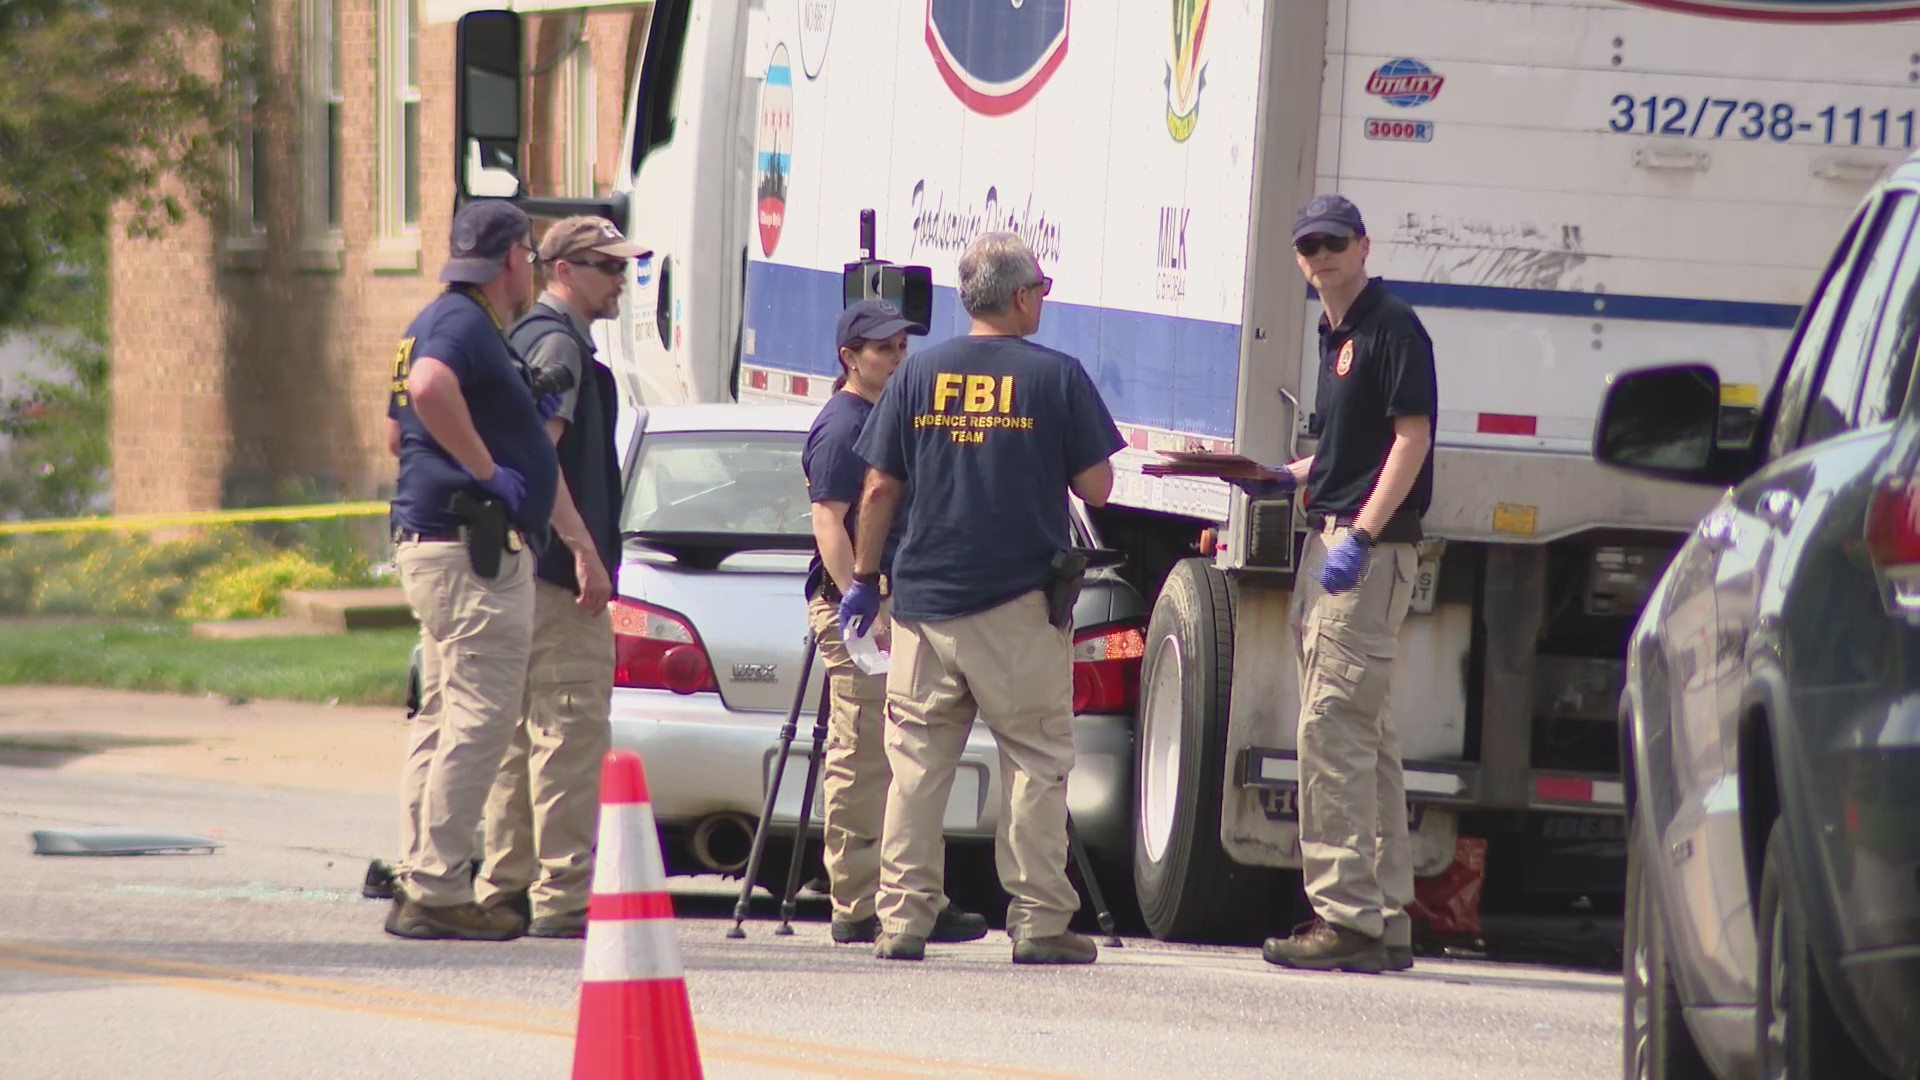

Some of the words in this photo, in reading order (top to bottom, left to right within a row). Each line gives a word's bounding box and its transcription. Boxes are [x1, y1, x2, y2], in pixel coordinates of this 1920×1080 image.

[1370, 76, 1439, 94] UTILITY
[1368, 121, 1427, 140] 3000R
[1608, 93, 1915, 149] 312/738-1111
[1156, 206, 1191, 270] MILK
[933, 372, 1014, 414] FBI
[913, 415, 967, 428] EVDENCE
[970, 415, 1035, 429] RESPONSE
[951, 430, 985, 444] TEAM
